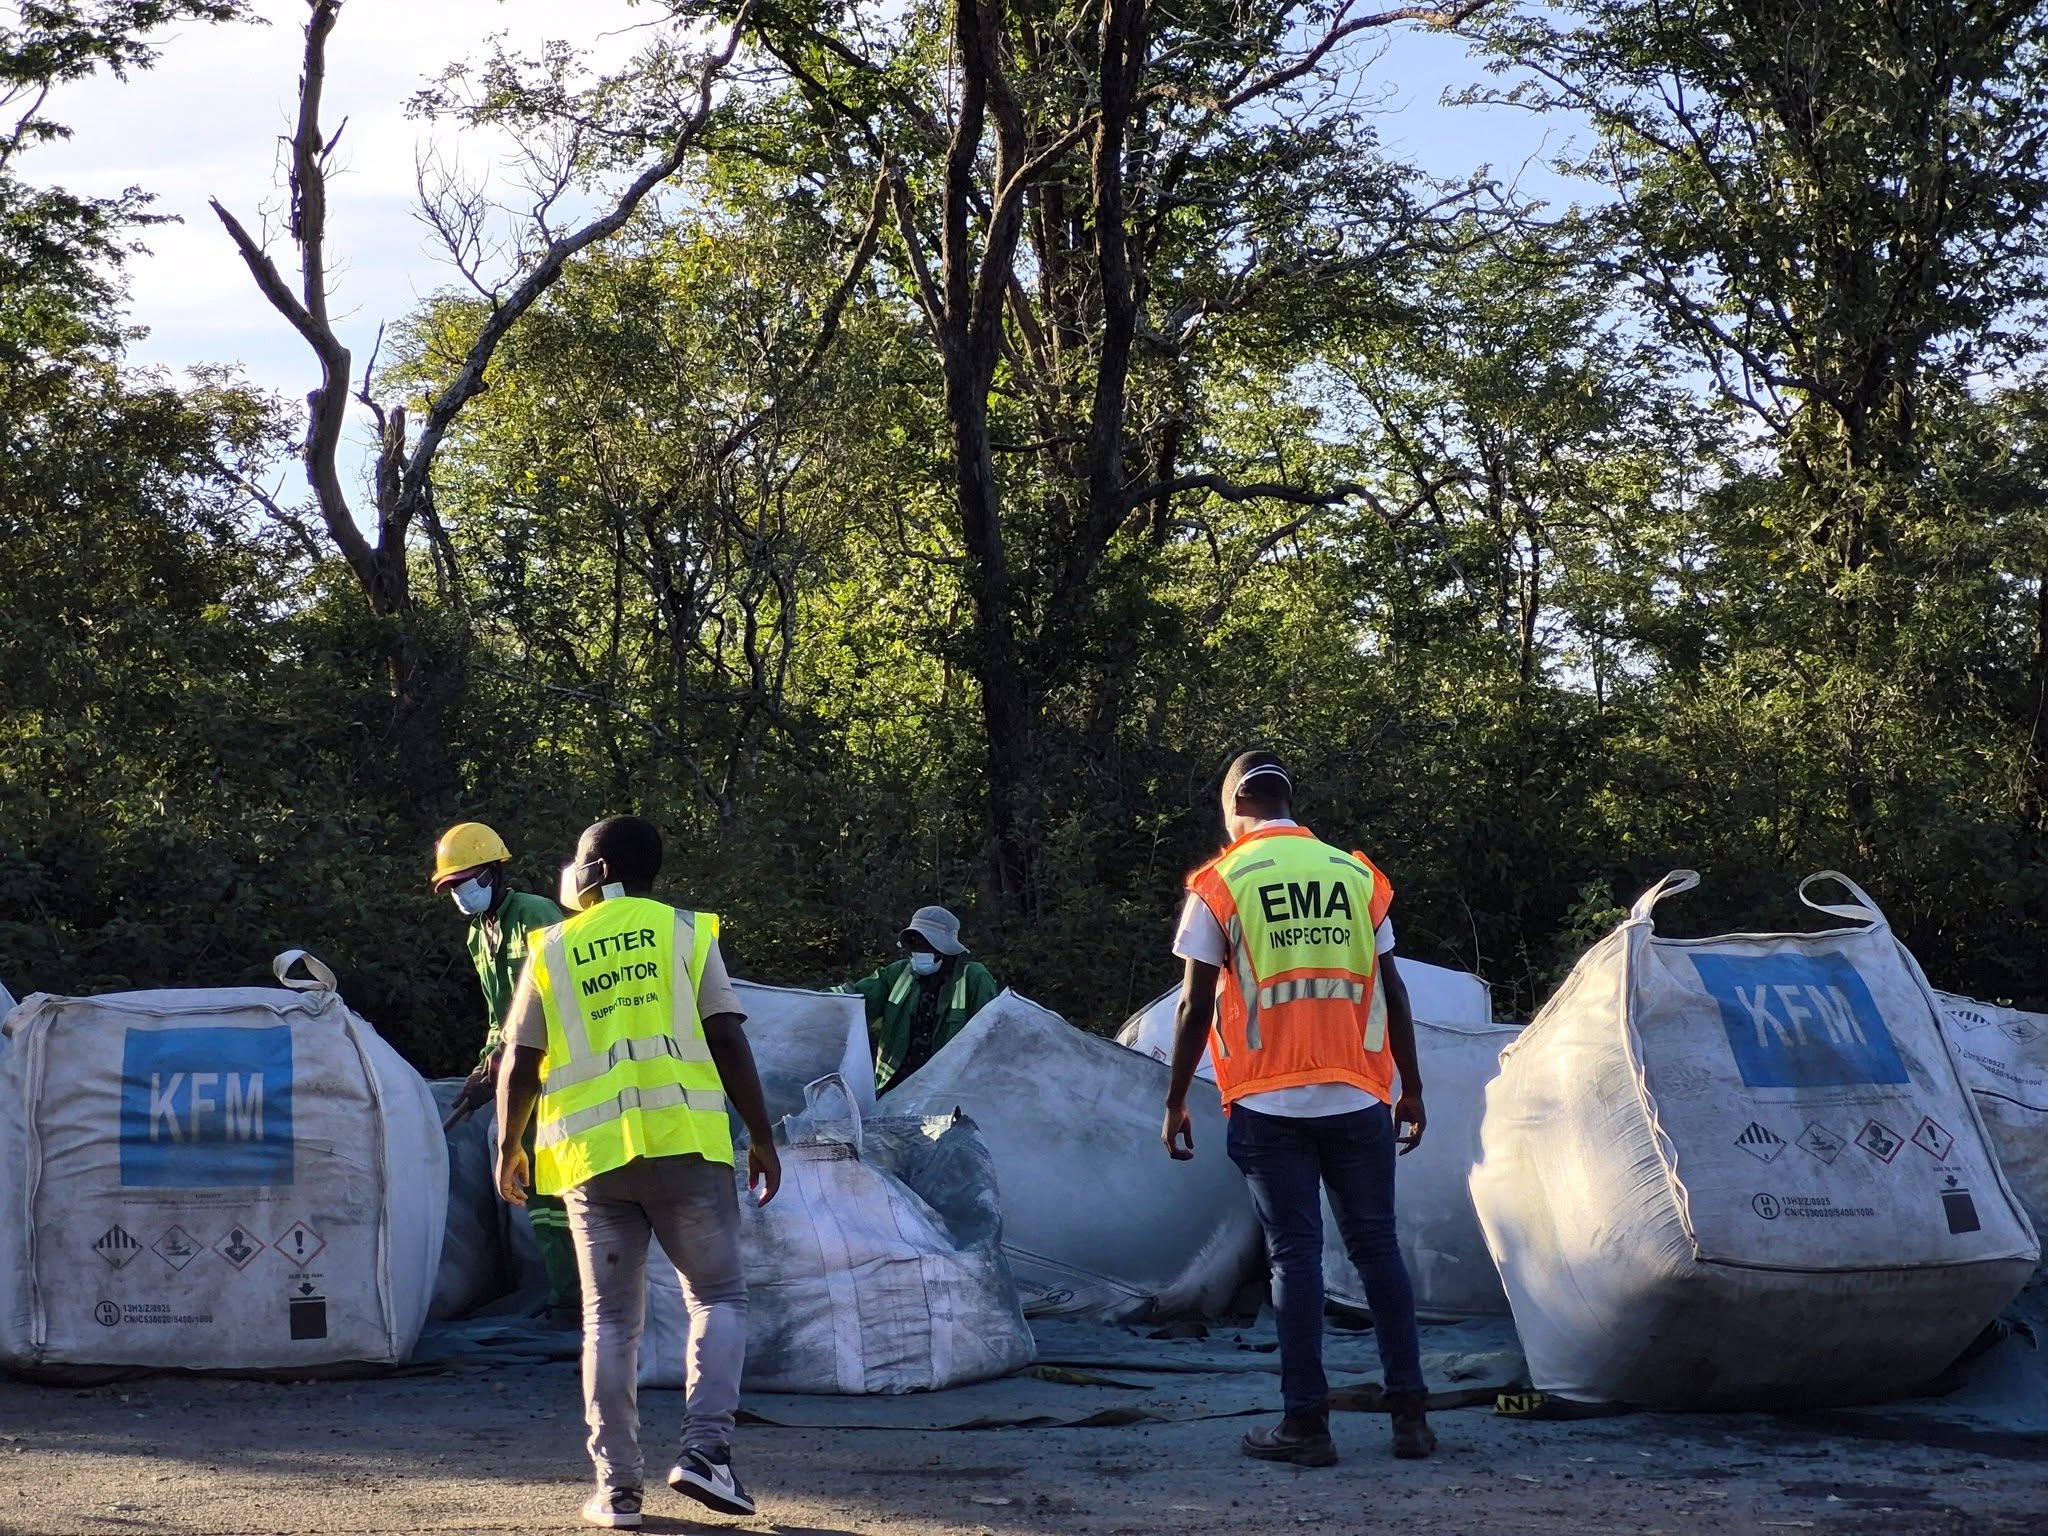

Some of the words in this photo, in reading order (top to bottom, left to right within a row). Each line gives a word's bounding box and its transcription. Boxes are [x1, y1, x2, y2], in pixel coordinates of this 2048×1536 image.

[1258, 881, 1352, 923] EMA
[573, 928, 656, 966] LITTER
[1270, 927, 1351, 949] INSPECTOR
[582, 961, 658, 996] MONITOR
[590, 997, 632, 1021] SUPPTED
[633, 995, 645, 1006] BY
[1734, 984, 1867, 1048] KFM
[150, 1072, 264, 1143] KFM
